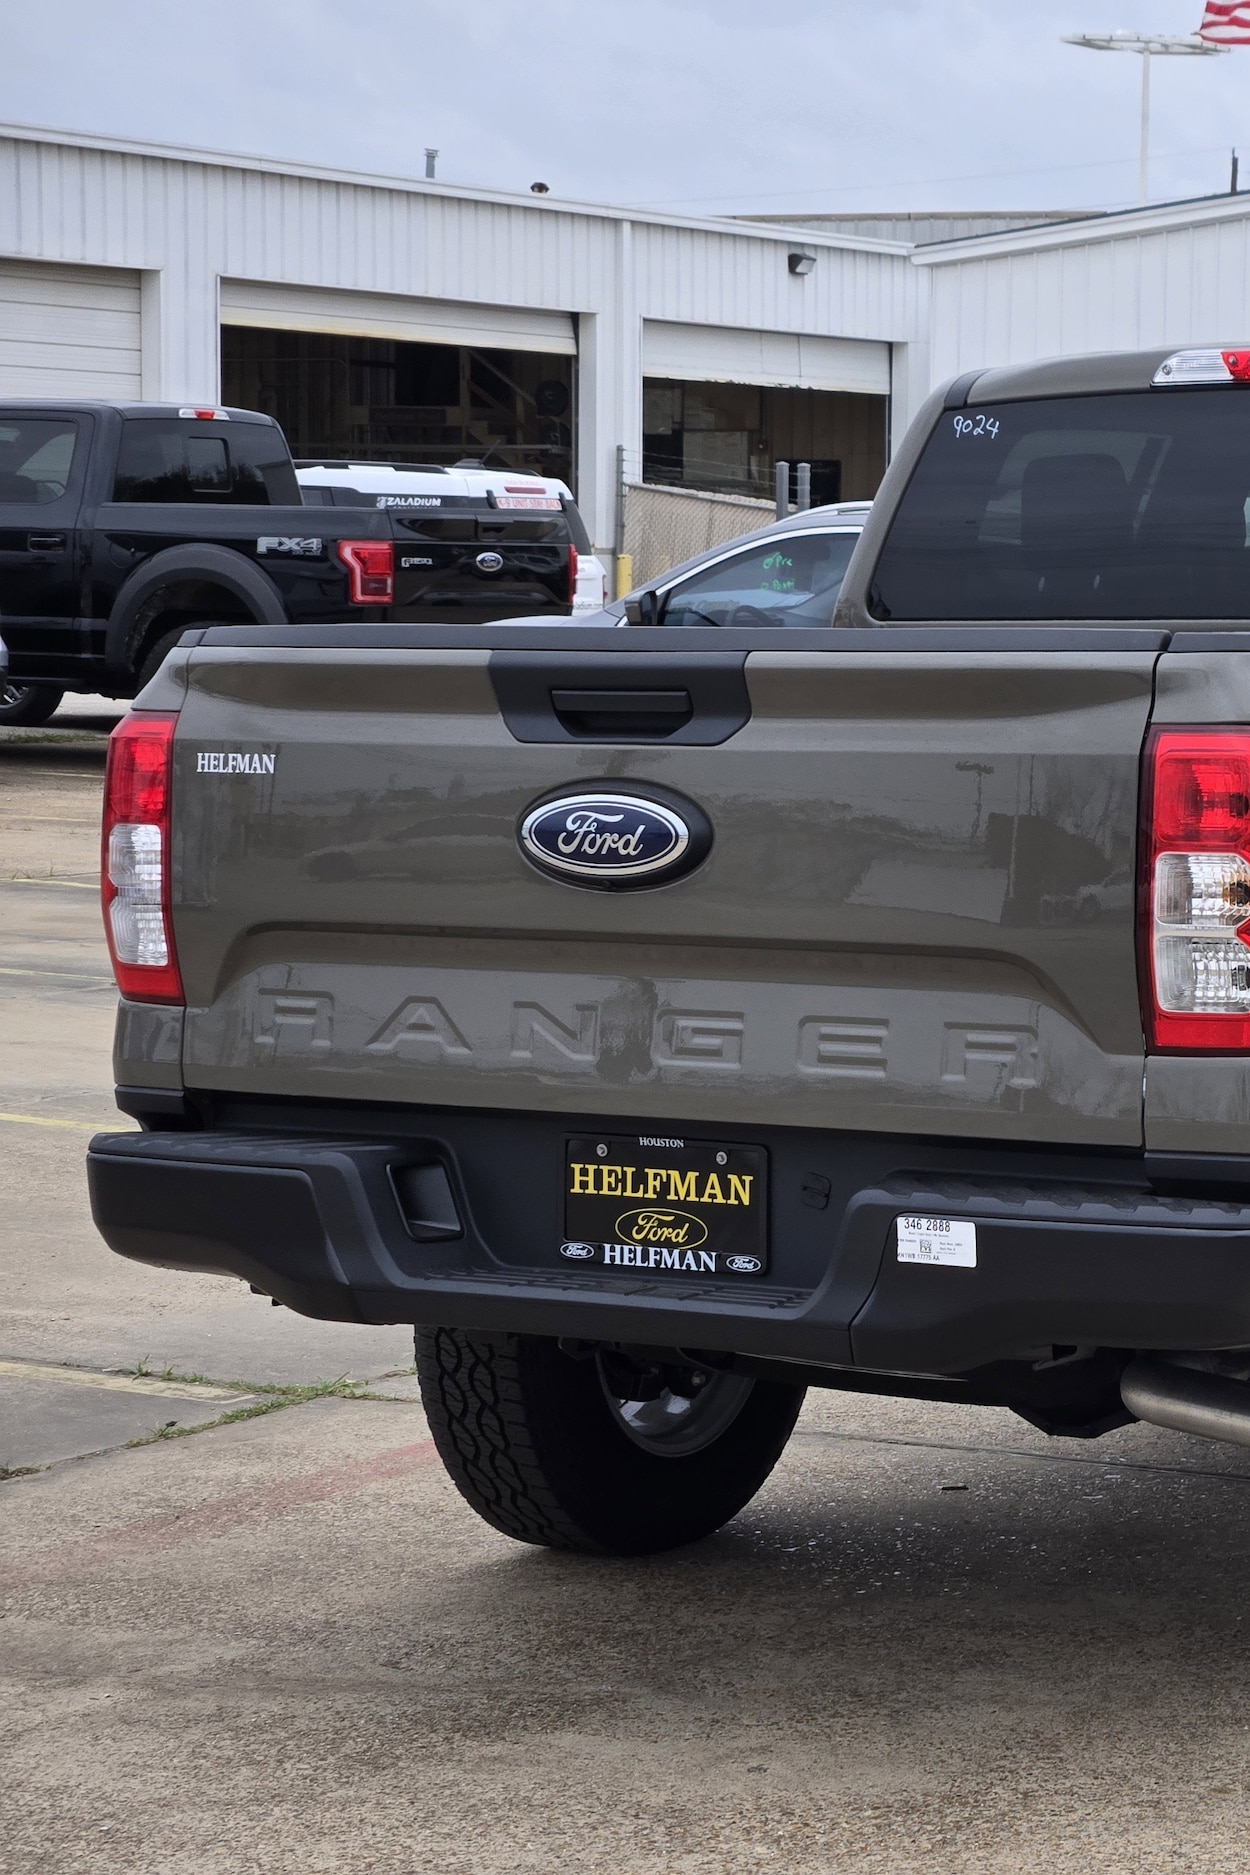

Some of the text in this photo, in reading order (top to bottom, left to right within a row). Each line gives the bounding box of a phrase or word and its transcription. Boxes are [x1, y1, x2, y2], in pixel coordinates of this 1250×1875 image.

[953, 415, 1000, 439] 9024
[386, 496, 442, 507] ZALADIUM
[256, 536, 322, 555] FX4
[196, 752, 277, 776] HELFMAN
[557, 809, 645, 857] Ford
[253, 986, 1040, 1090] RANGER
[638, 1136, 685, 1149] HOUSTON
[569, 1162, 754, 1207] HELFMAN
[631, 1212, 690, 1244] Ford
[904, 1218, 951, 1232] 346 2888
[566, 1245, 589, 1257] Ford
[603, 1243, 717, 1273] HELFMAN
[732, 1257, 755, 1270] Ford
